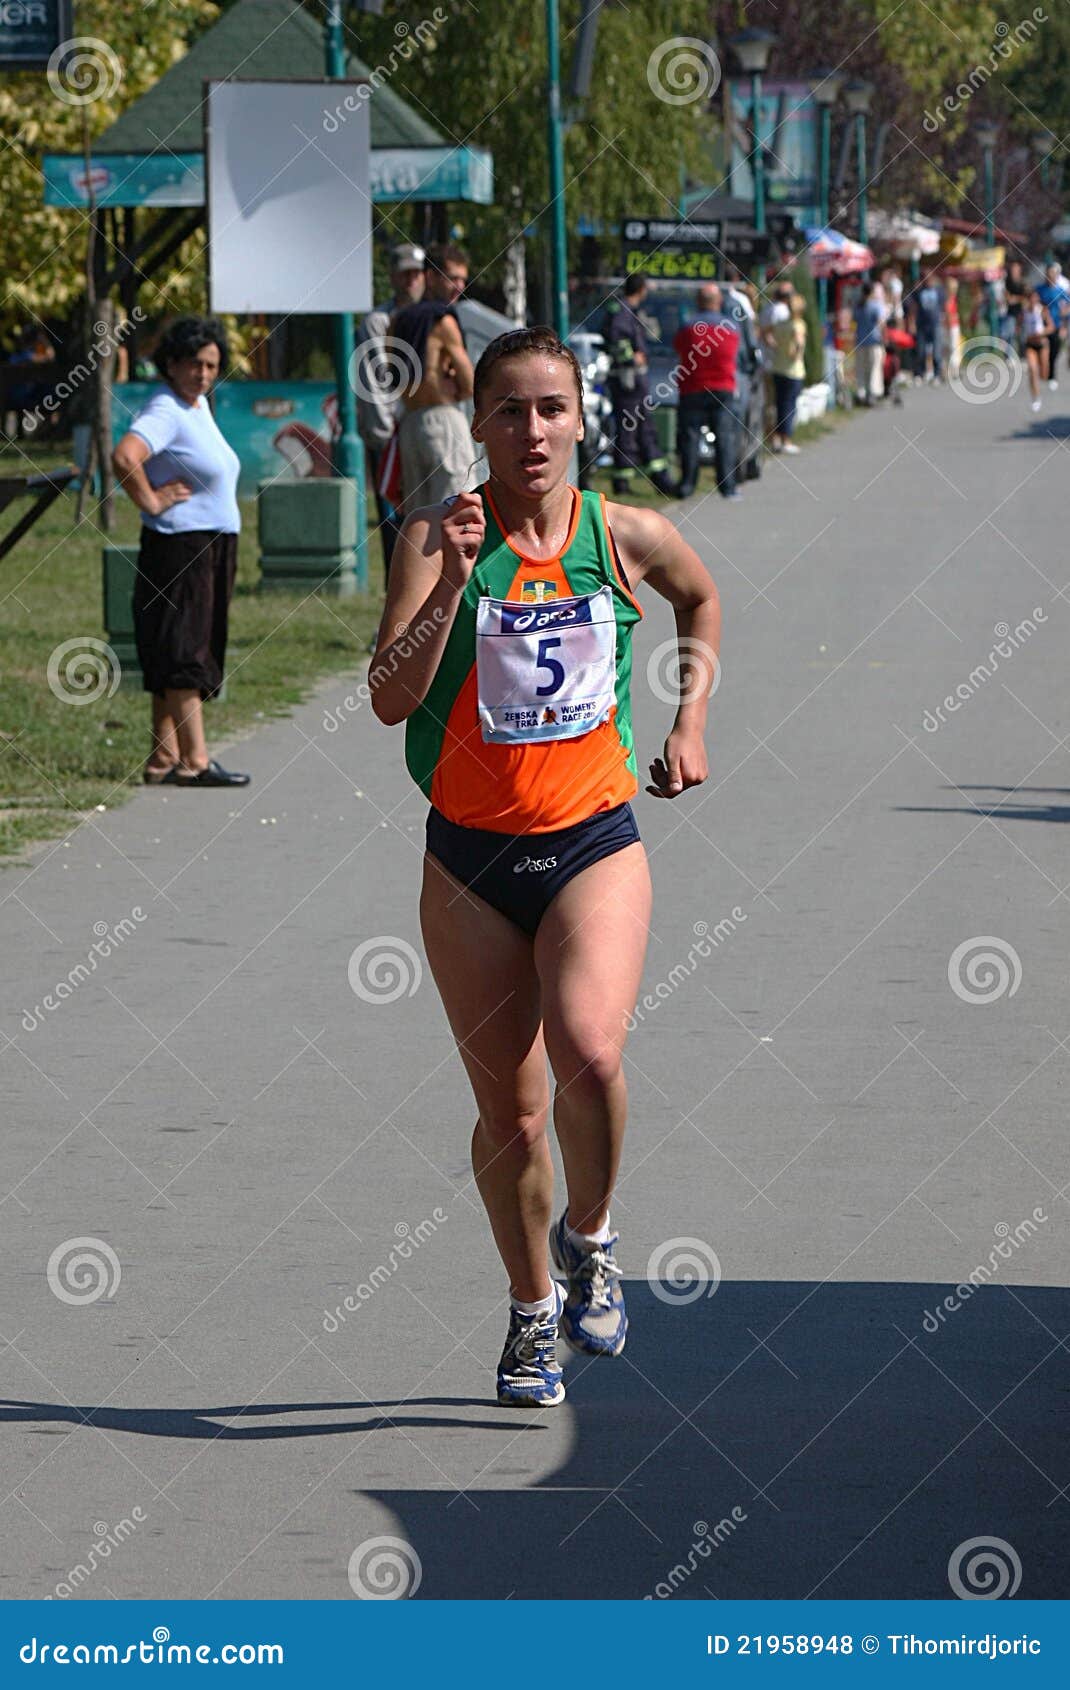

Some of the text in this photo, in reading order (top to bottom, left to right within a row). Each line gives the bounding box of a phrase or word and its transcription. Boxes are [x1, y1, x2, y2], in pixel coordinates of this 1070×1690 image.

[536, 636, 565, 696] 5
[515, 719, 539, 729] TRKA
[562, 712, 582, 723] RACE
[528, 856, 558, 872] asics
